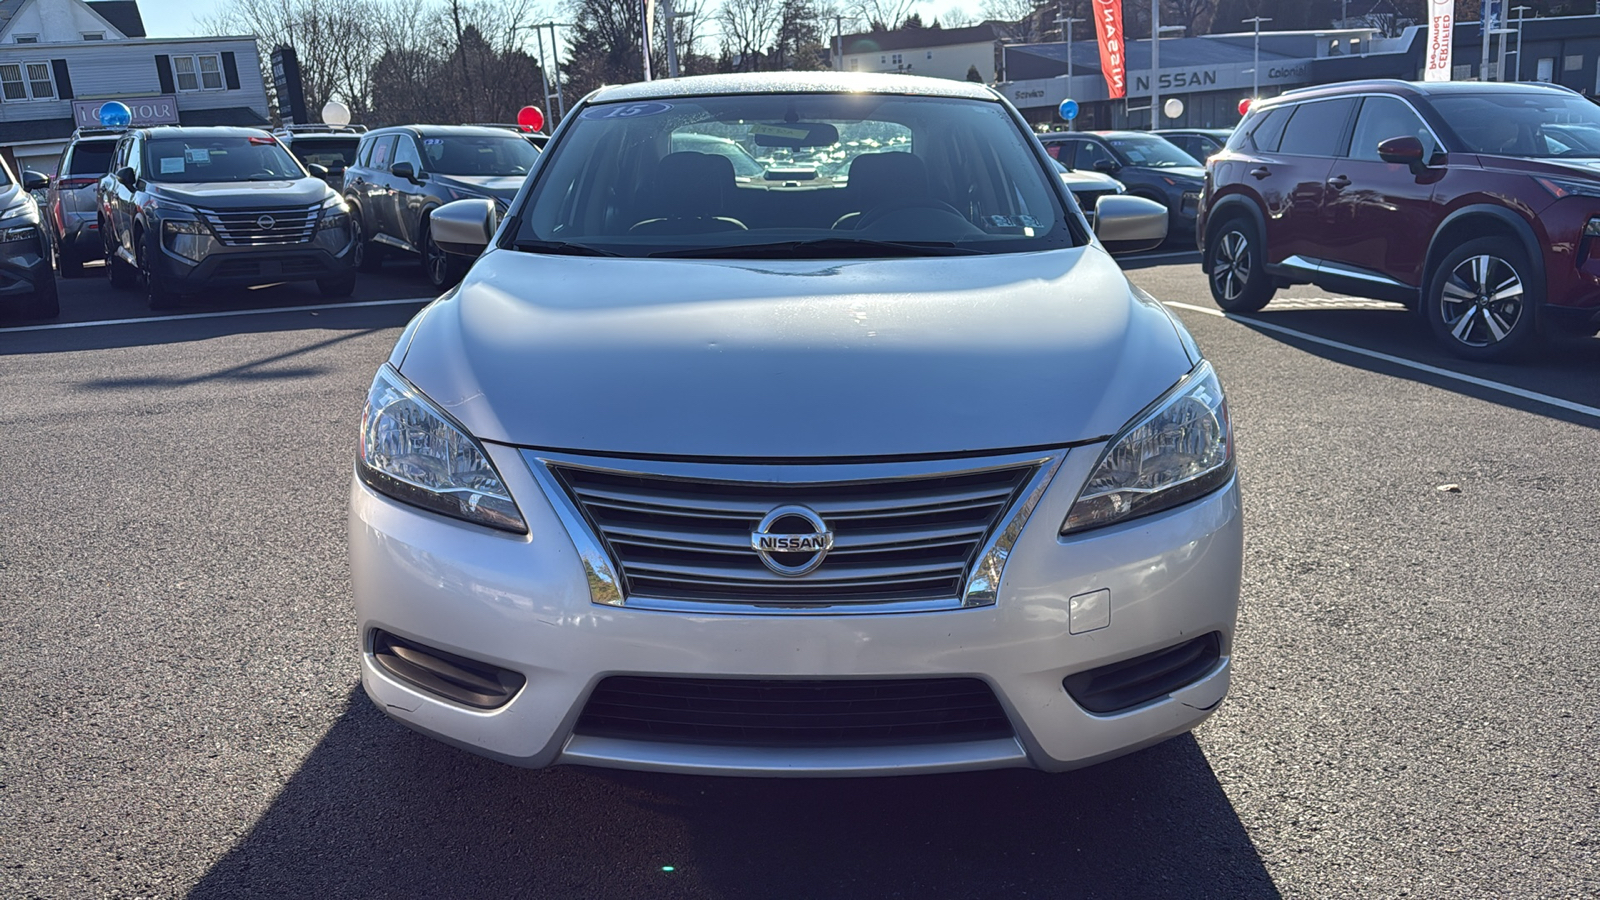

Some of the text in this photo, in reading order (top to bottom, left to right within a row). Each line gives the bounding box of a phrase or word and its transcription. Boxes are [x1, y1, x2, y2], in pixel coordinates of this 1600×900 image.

[1136, 70, 1217, 92] NSSAN
[91, 104, 171, 122] CTOUR
[603, 104, 649, 118] 15
[760, 537, 824, 548] NISSAN
